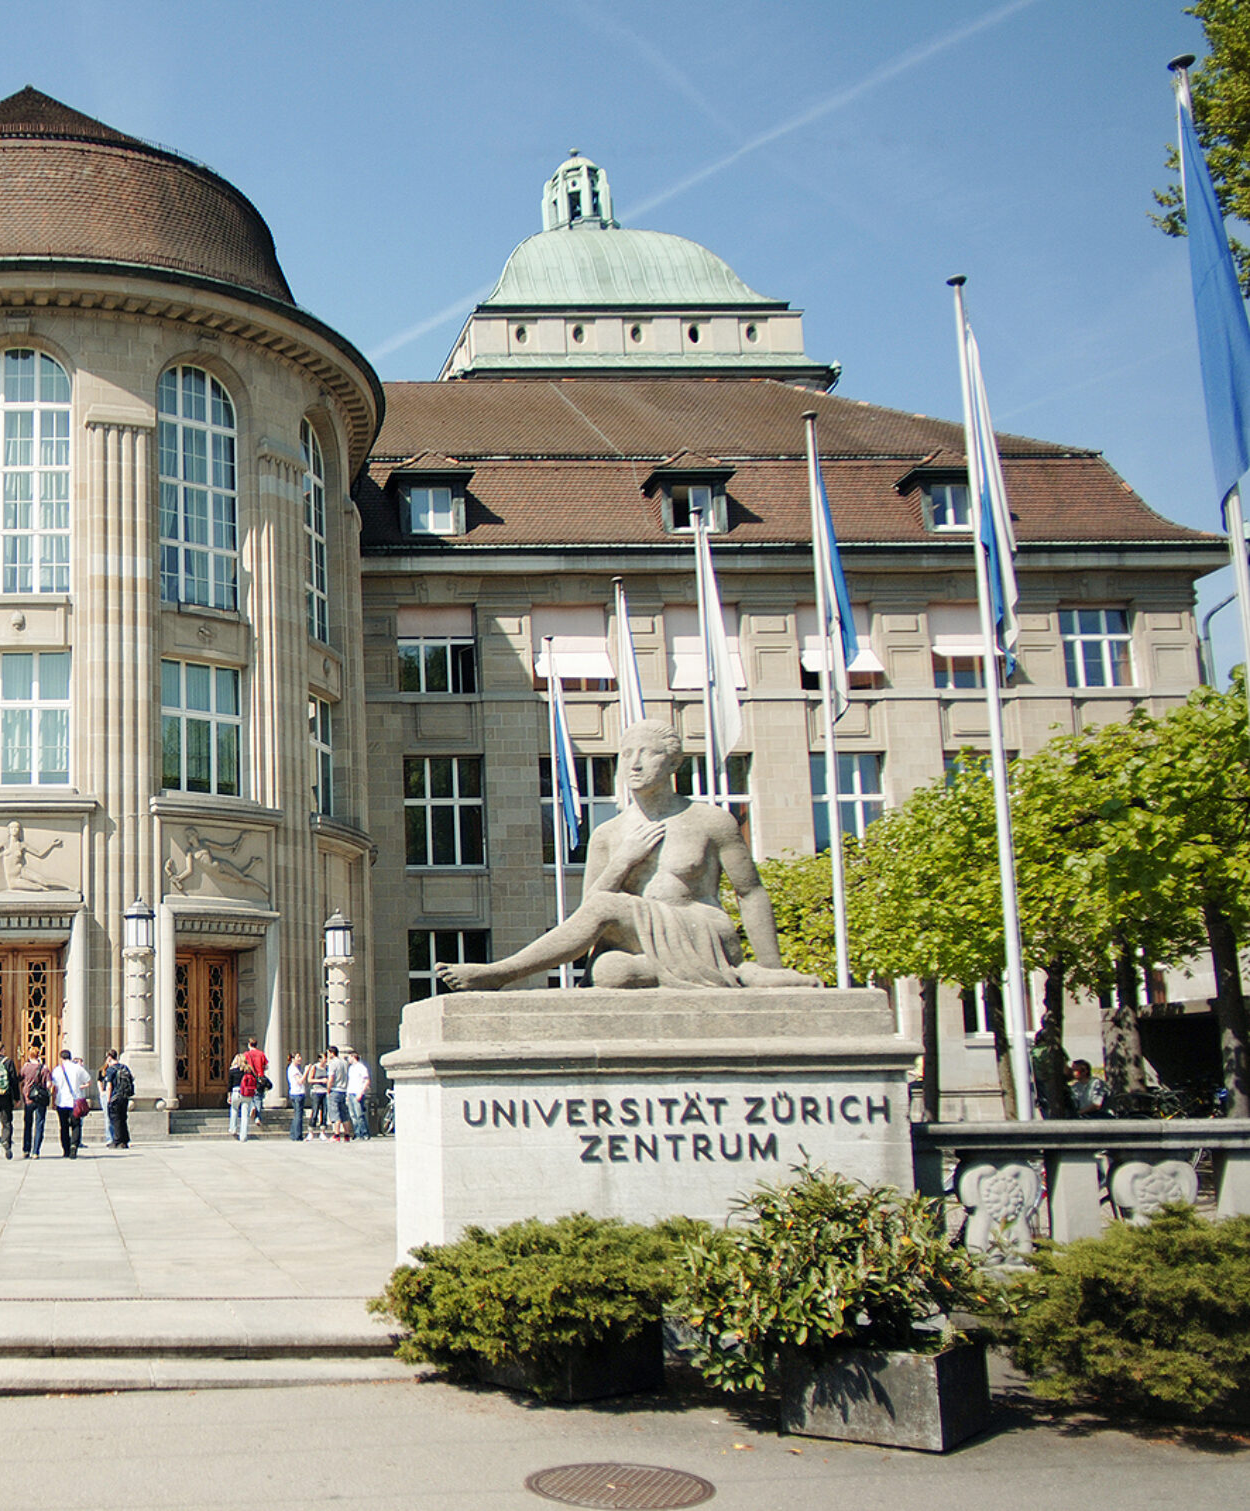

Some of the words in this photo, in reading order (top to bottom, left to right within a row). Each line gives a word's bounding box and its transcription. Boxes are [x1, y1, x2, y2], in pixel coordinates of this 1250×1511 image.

[463, 1092, 729, 1128] UNIVERSITÄT
[744, 1091, 891, 1124] ZÜRICH
[579, 1132, 779, 1163] ZENTRUM
